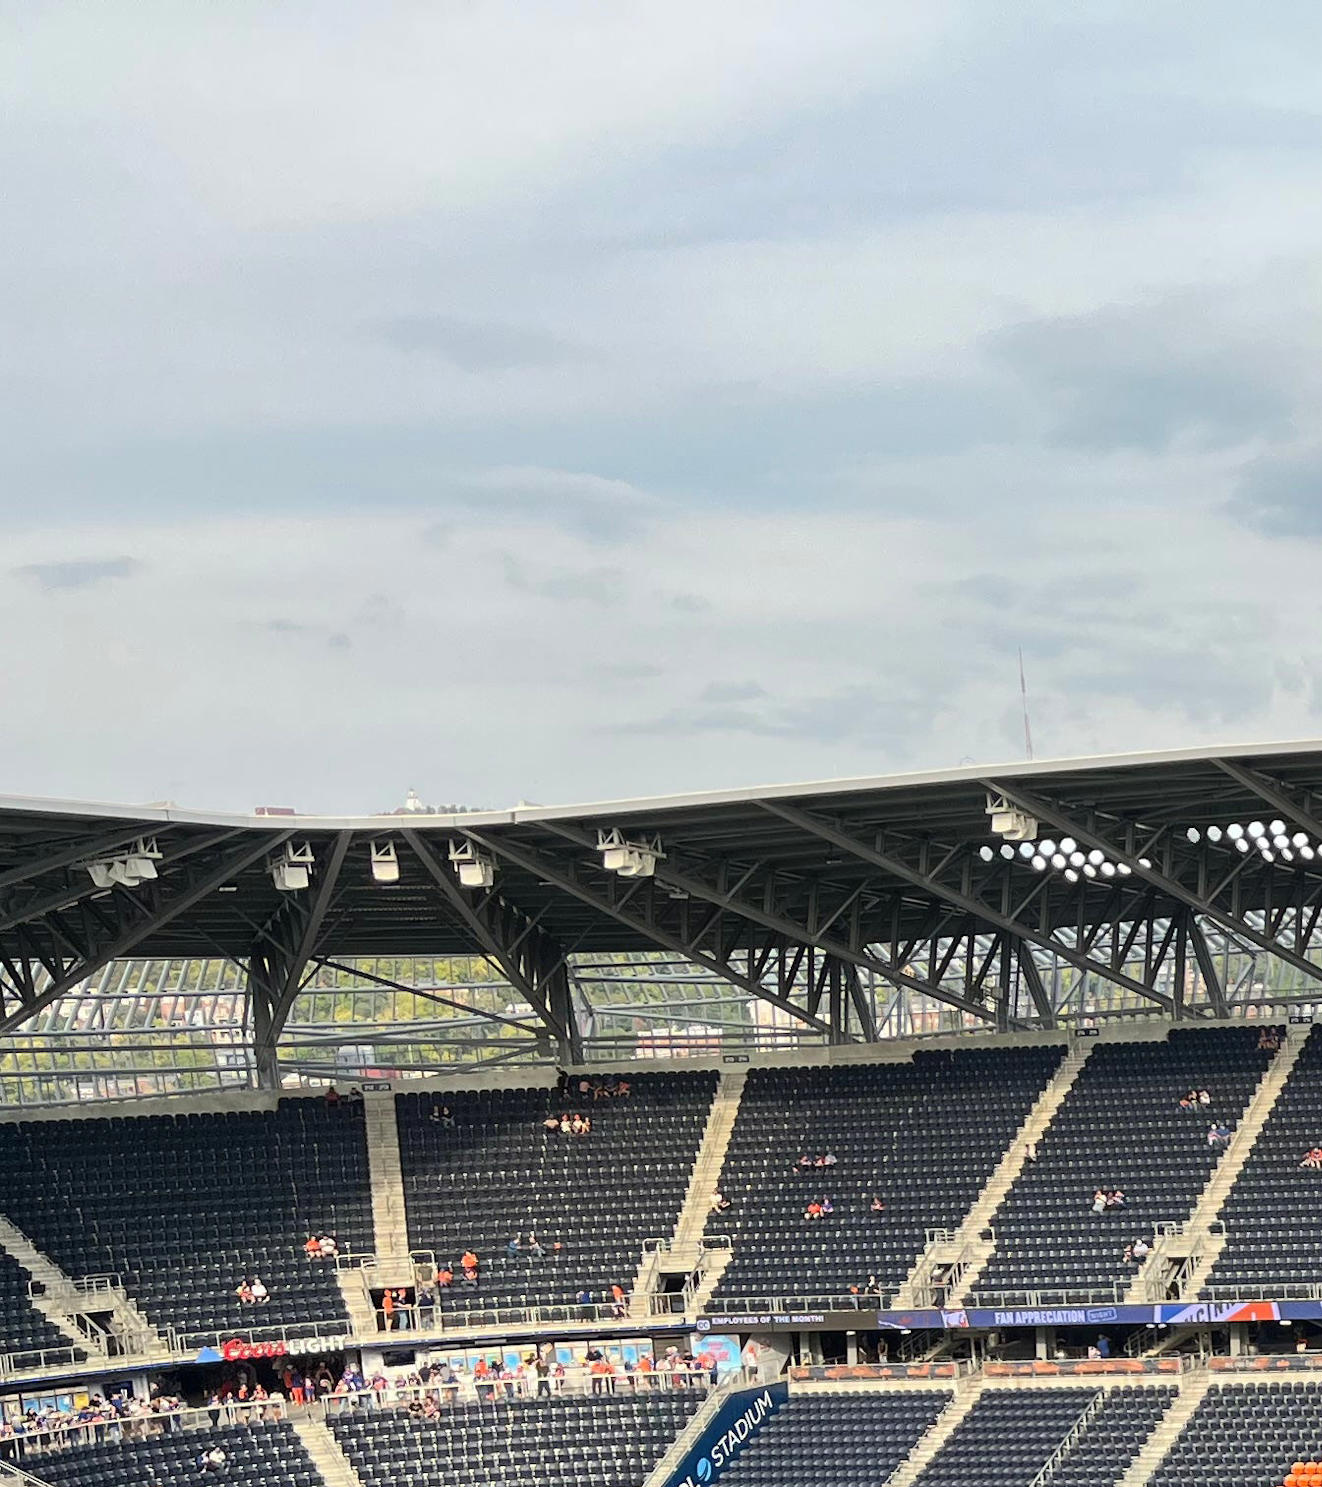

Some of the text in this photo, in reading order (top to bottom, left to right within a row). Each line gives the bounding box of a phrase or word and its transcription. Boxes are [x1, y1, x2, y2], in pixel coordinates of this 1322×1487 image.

[711, 1315, 824, 1325] EMPLOYEES OF THE MONTH!
[994, 1311, 1014, 1324] FAN
[1015, 1309, 1085, 1324] APPRECIATION
[222, 1334, 345, 1361] Coors LIGHT
[711, 1390, 773, 1467] STADIUM
